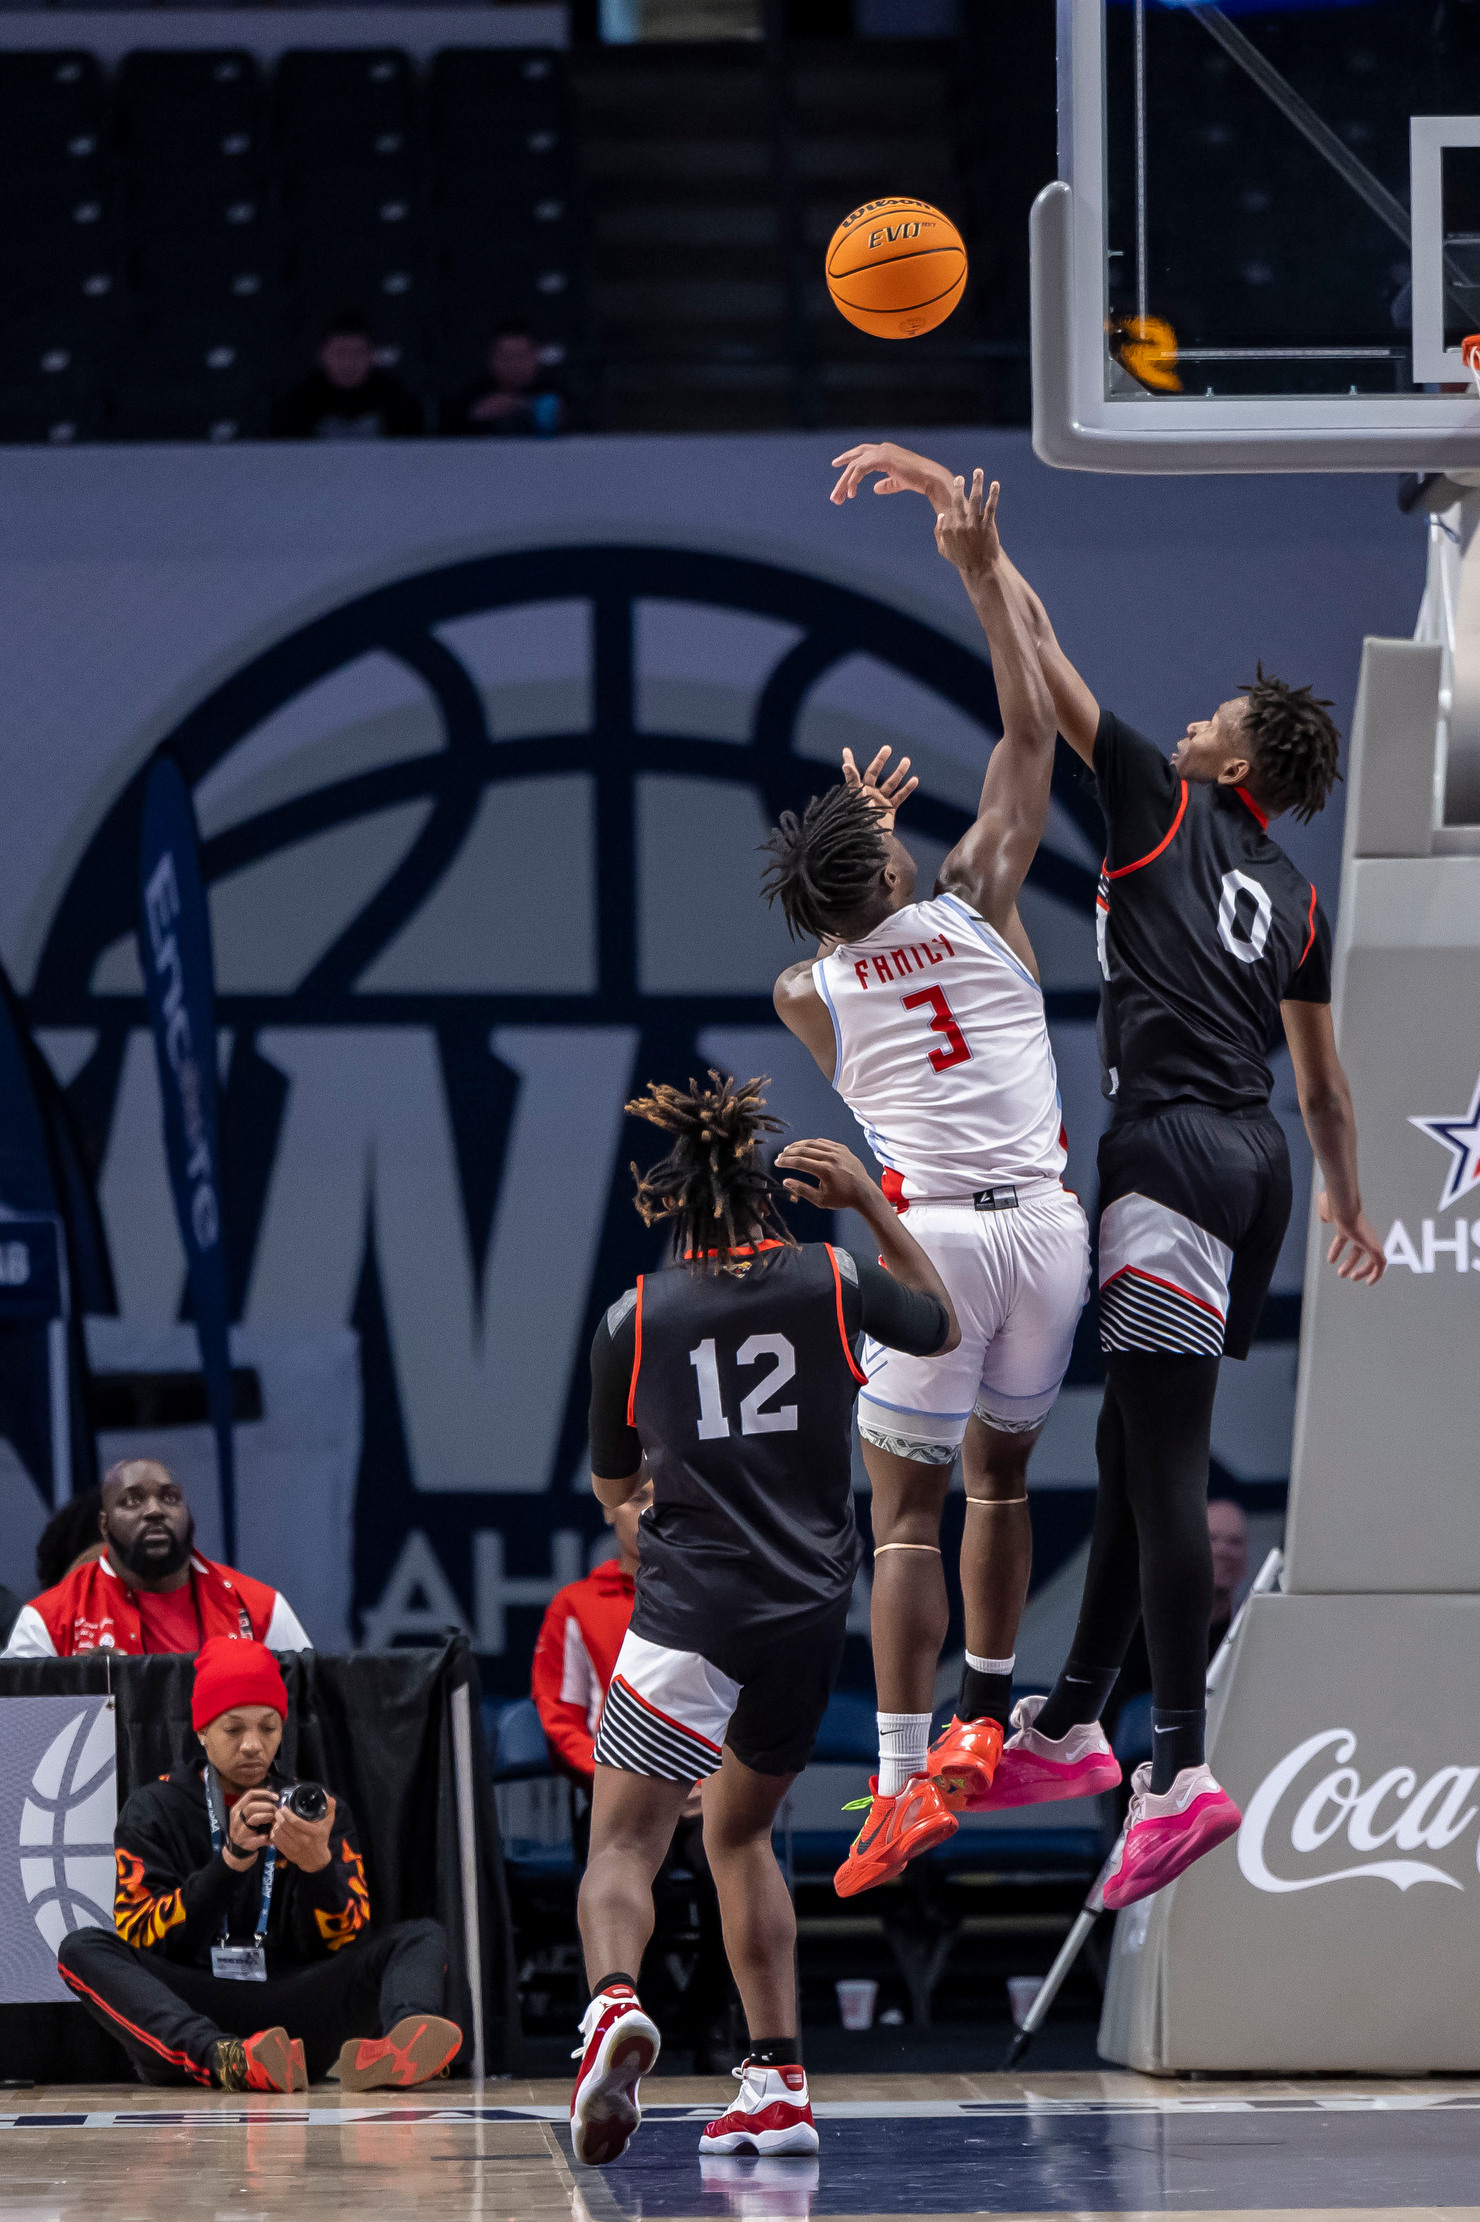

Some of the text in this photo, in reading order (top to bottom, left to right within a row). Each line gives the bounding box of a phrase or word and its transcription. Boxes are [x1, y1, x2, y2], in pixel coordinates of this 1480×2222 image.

[868, 222, 920, 250] EVO
[1217, 869, 1272, 963] 0
[854, 934, 955, 990] FAMILY
[900, 982, 974, 1075] 3
[1382, 1218, 1480, 1274] AH
[689, 1332, 798, 1440] 12
